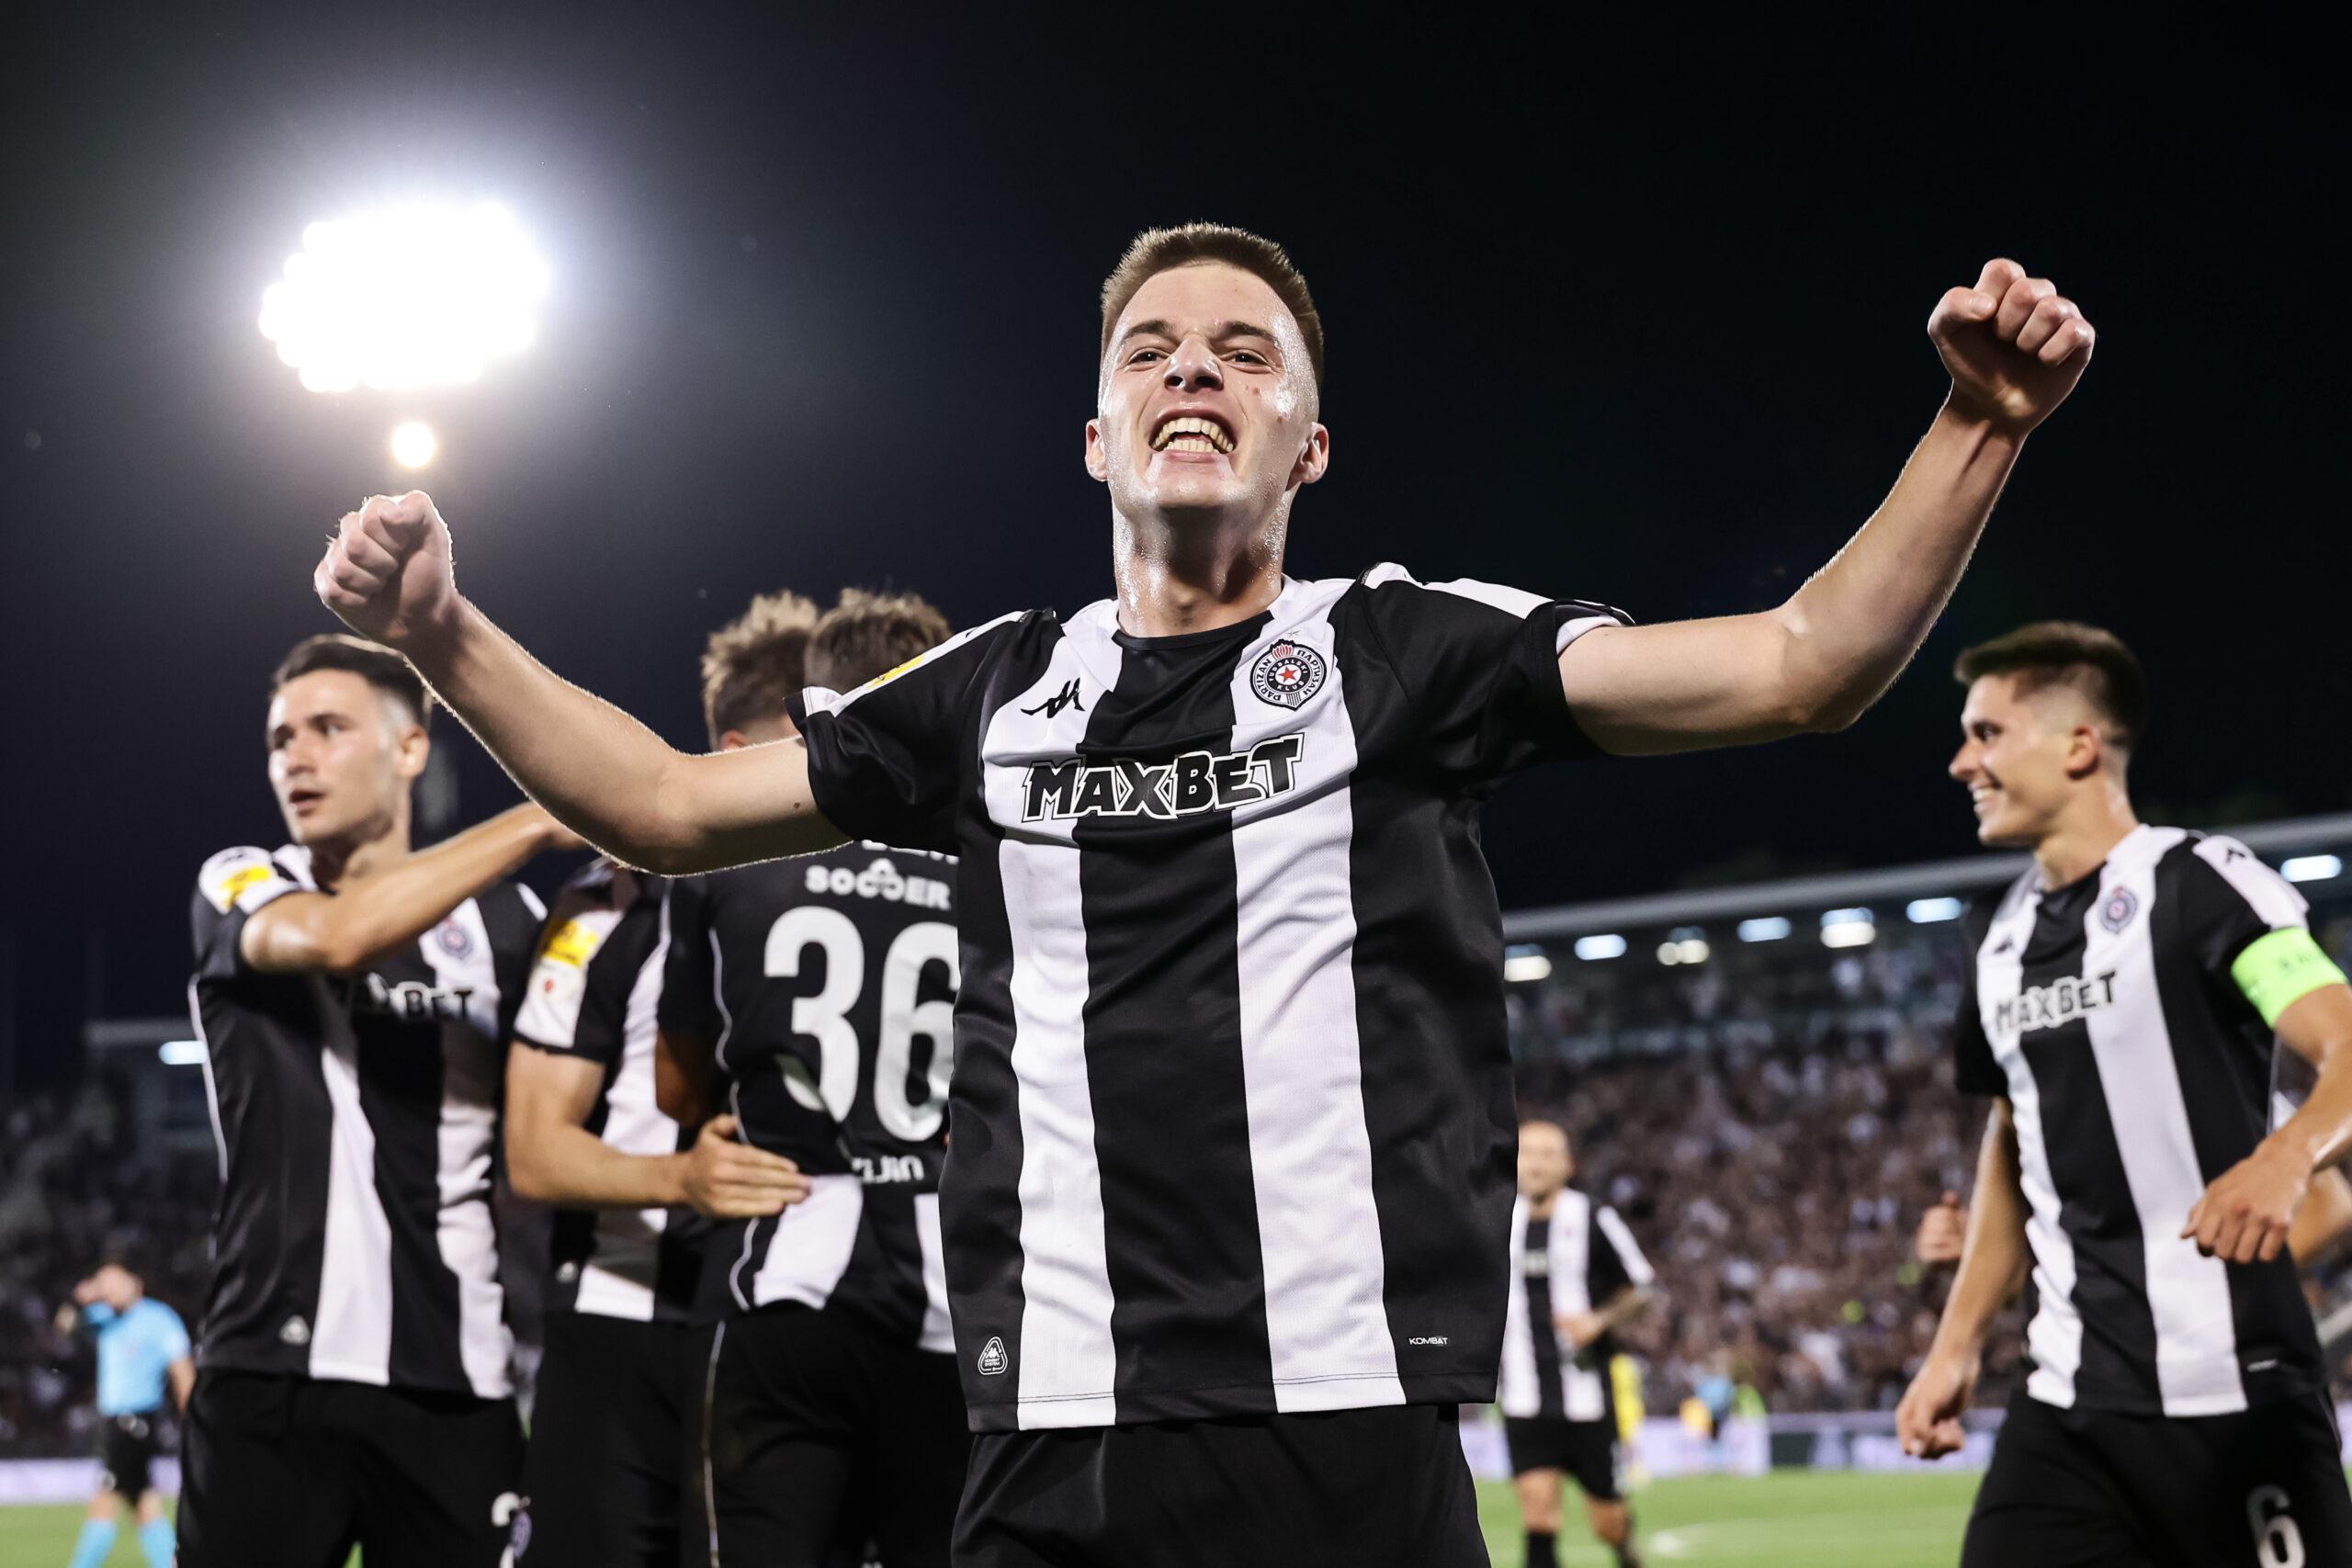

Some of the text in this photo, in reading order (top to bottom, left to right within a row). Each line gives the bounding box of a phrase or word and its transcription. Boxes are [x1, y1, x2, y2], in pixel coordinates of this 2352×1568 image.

[1256, 659, 1282, 701] PARTIZAN
[1022, 732, 1305, 823] MAXBET
[763, 906, 961, 1142] 36
[1995, 970, 2118, 1034] MAXBET
[1408, 1337, 1448, 1346] KOMBAT
[2246, 1483, 2306, 1568] 6
